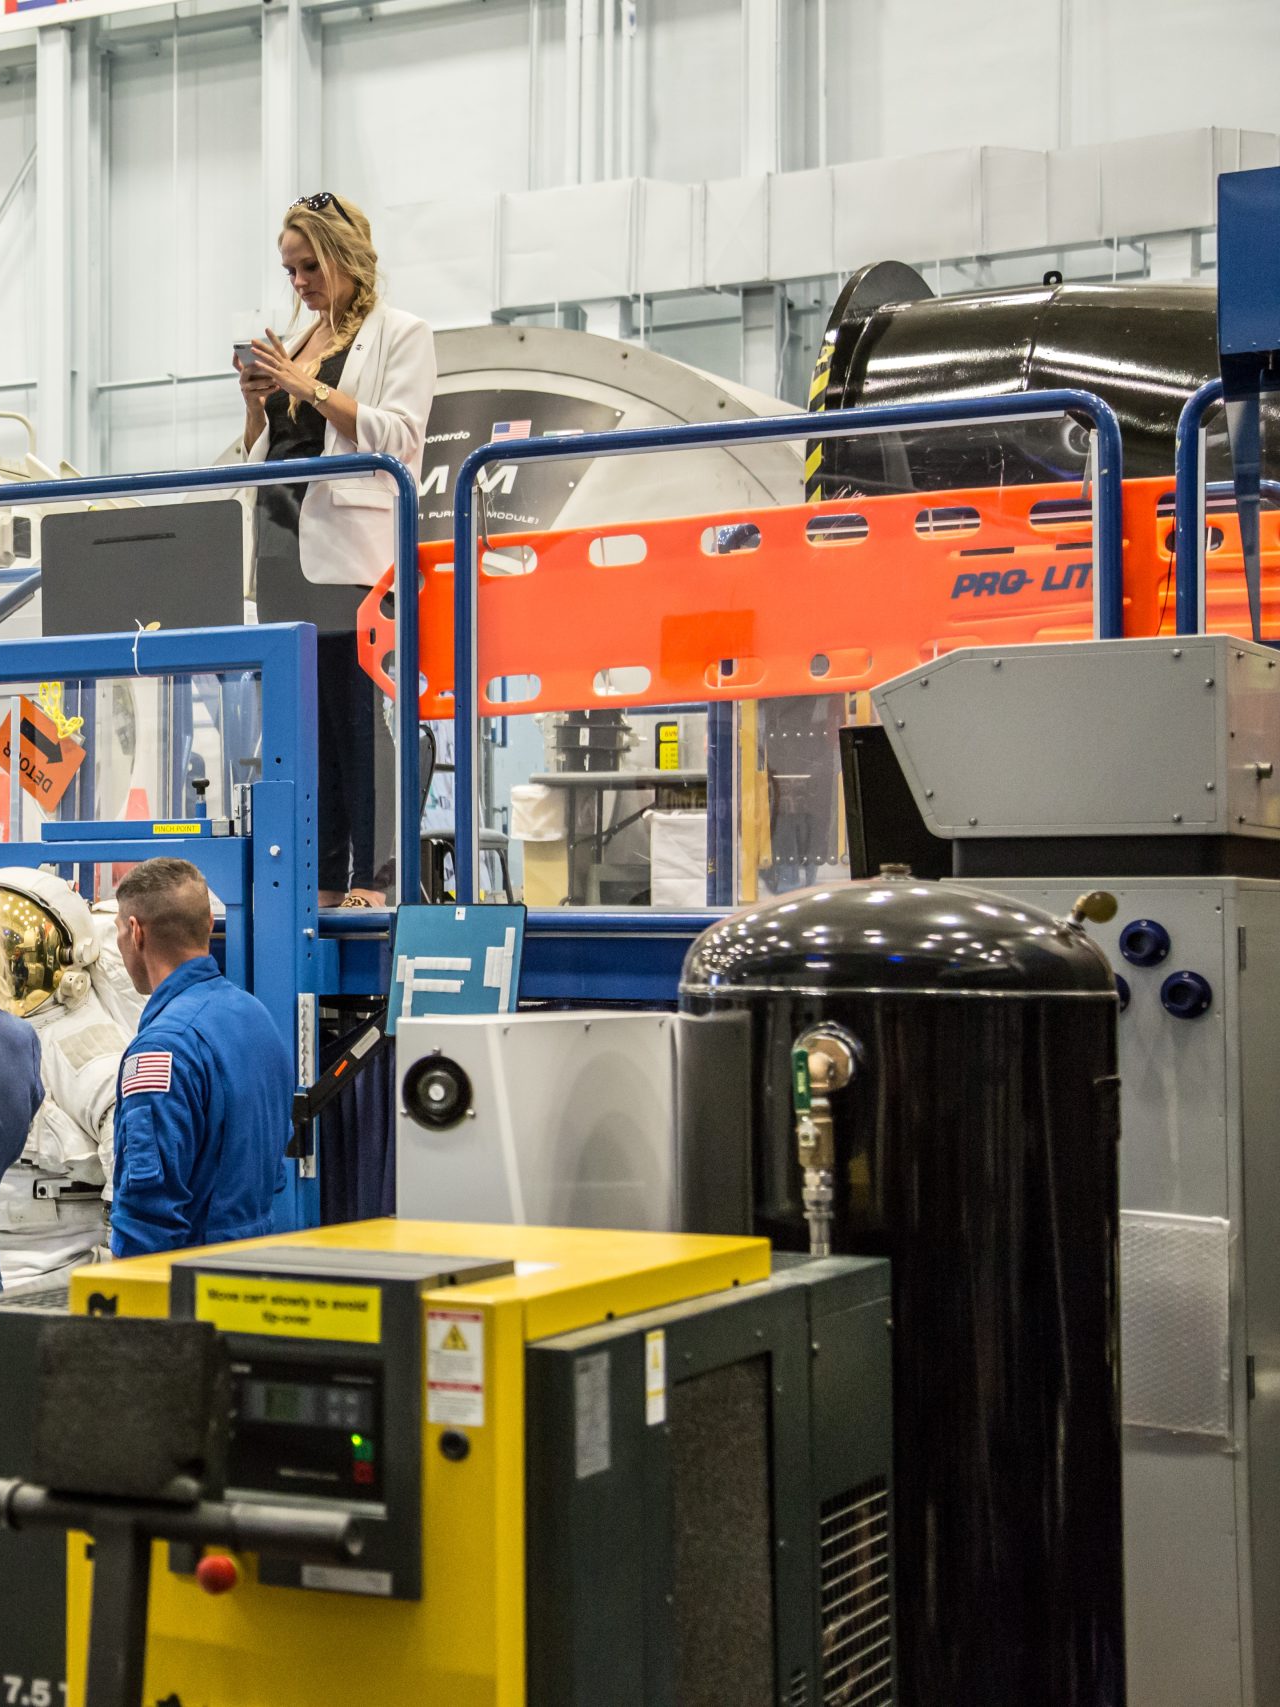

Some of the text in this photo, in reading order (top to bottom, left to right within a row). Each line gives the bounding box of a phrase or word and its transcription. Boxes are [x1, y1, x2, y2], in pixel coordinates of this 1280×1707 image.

[425, 430, 470, 444] onardo
[1040, 562, 1093, 592] LIT
[2, 741, 54, 794] DETOR
[154, 825, 195, 833] PINCH POINT
[314, 1296, 328, 1310] to
[2, 1674, 52, 1707] 7.5
